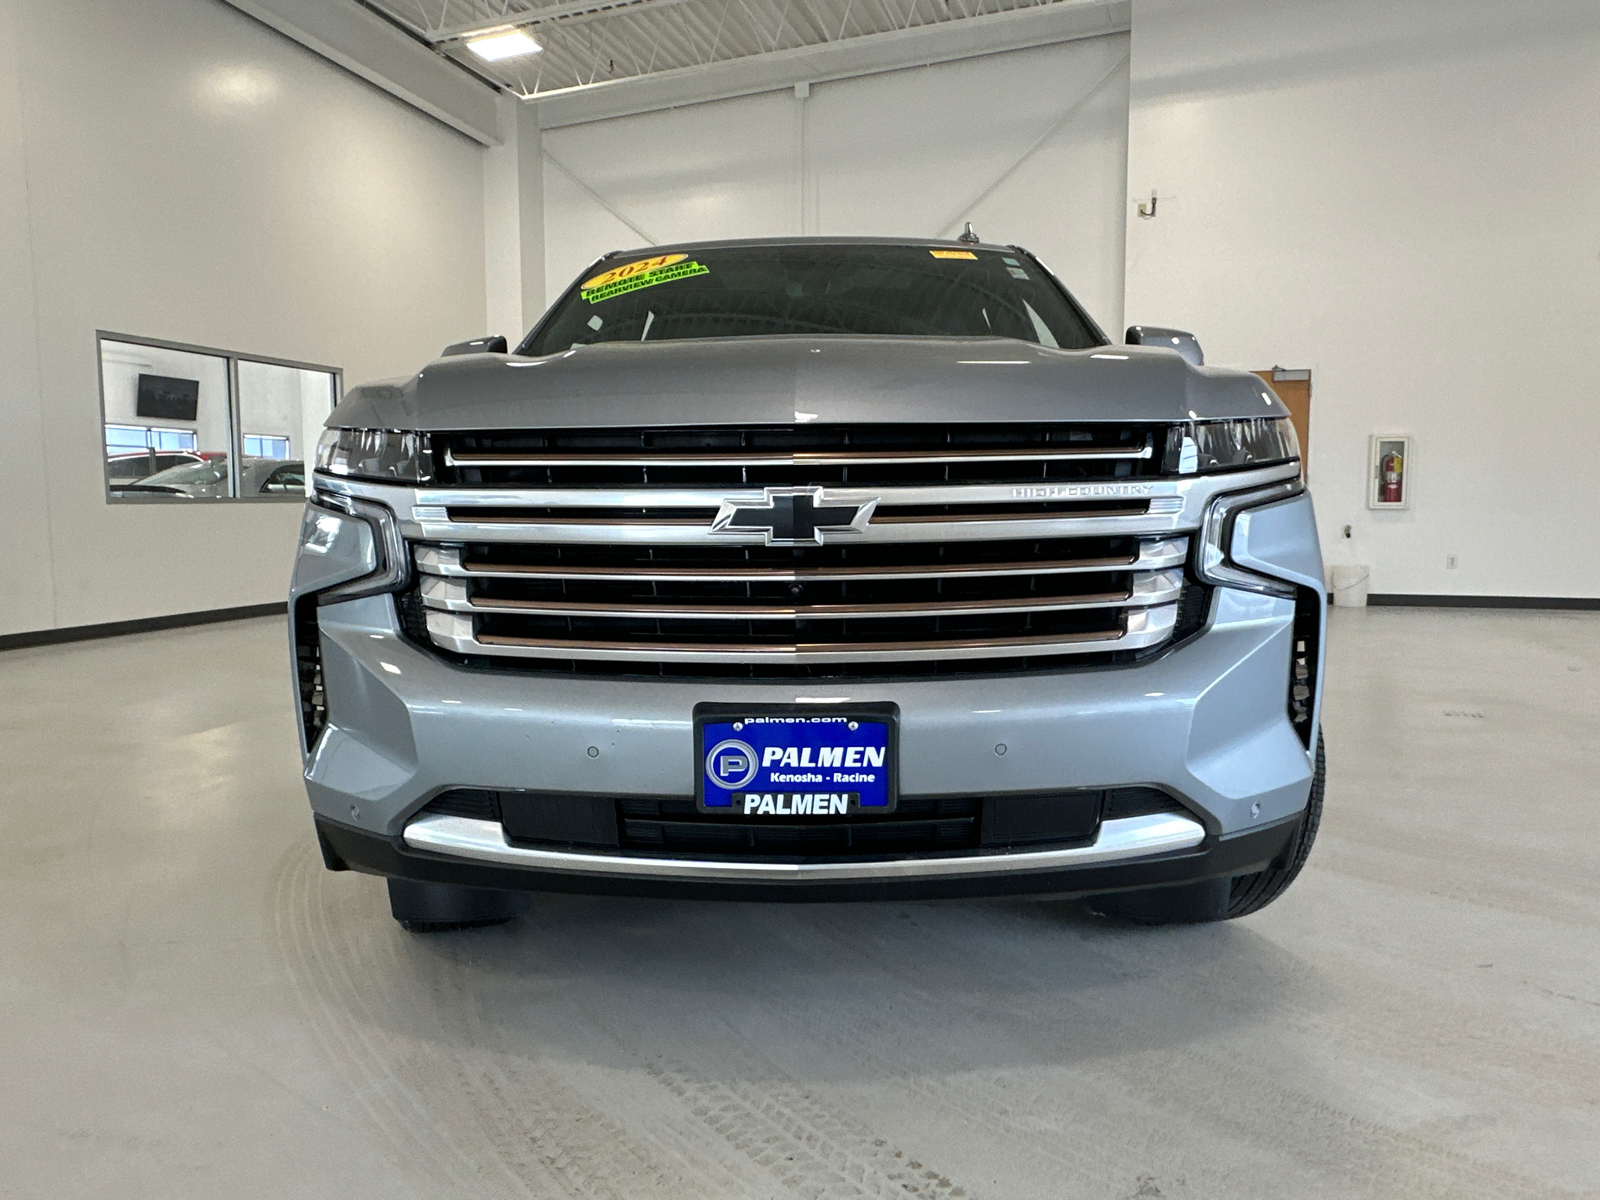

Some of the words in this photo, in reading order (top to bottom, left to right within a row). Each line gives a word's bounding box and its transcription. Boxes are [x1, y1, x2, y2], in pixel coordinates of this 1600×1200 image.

[586, 273, 645, 296] REMOTE
[648, 263, 694, 277] START
[601, 256, 667, 284] 2024
[591, 279, 654, 302] REARVIEW
[655, 267, 708, 282] CAMERA
[1012, 488, 1059, 498] HIGH
[1066, 485, 1154, 496] COUNTRY
[720, 755, 748, 777] P
[762, 746, 886, 768] PALMEN
[770, 772, 822, 783] Kenosha
[833, 772, 876, 783] Racine
[743, 794, 849, 815] PALMEN
